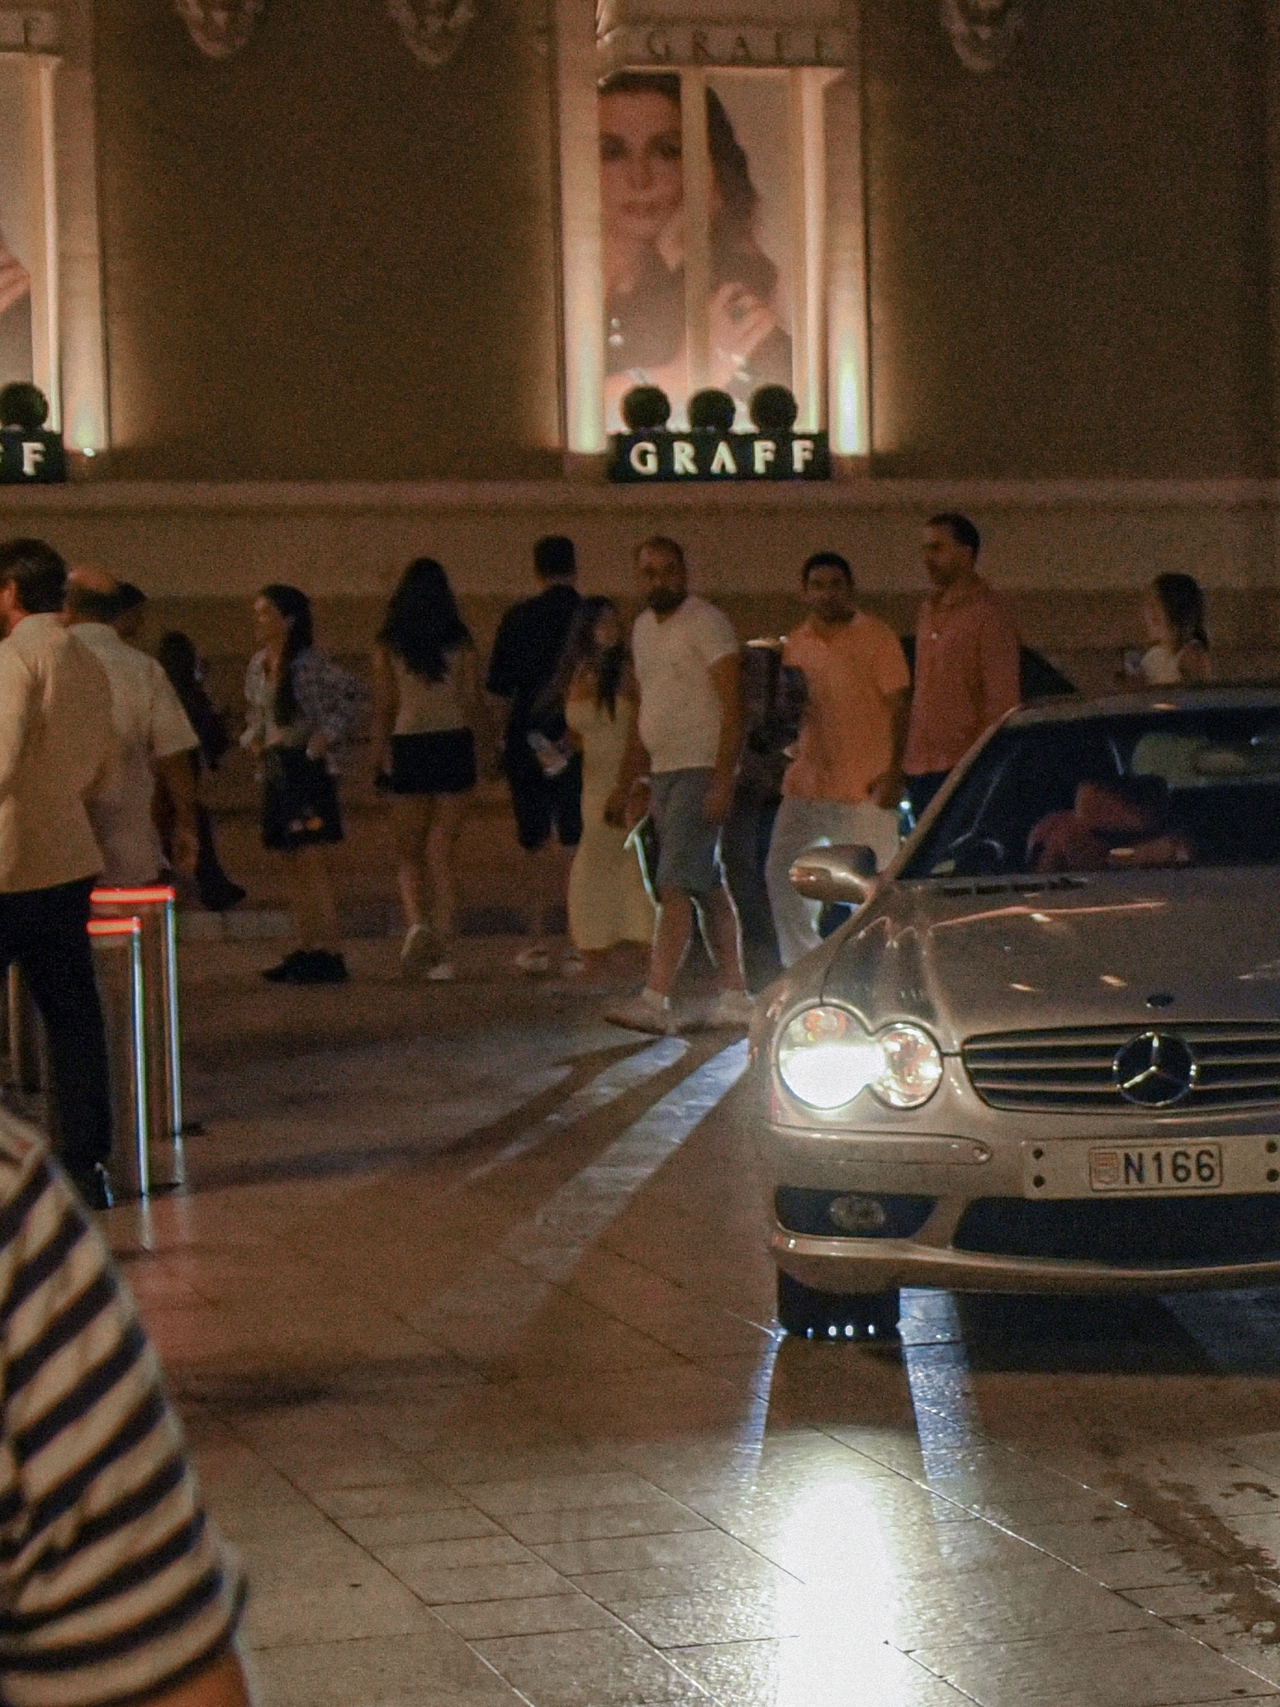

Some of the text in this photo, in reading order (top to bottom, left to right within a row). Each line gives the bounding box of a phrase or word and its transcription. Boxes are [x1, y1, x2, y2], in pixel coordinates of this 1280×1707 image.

[0, 441, 46, 477] F
[629, 439, 815, 475] GRAFF
[1123, 1149, 1216, 1185] N166
